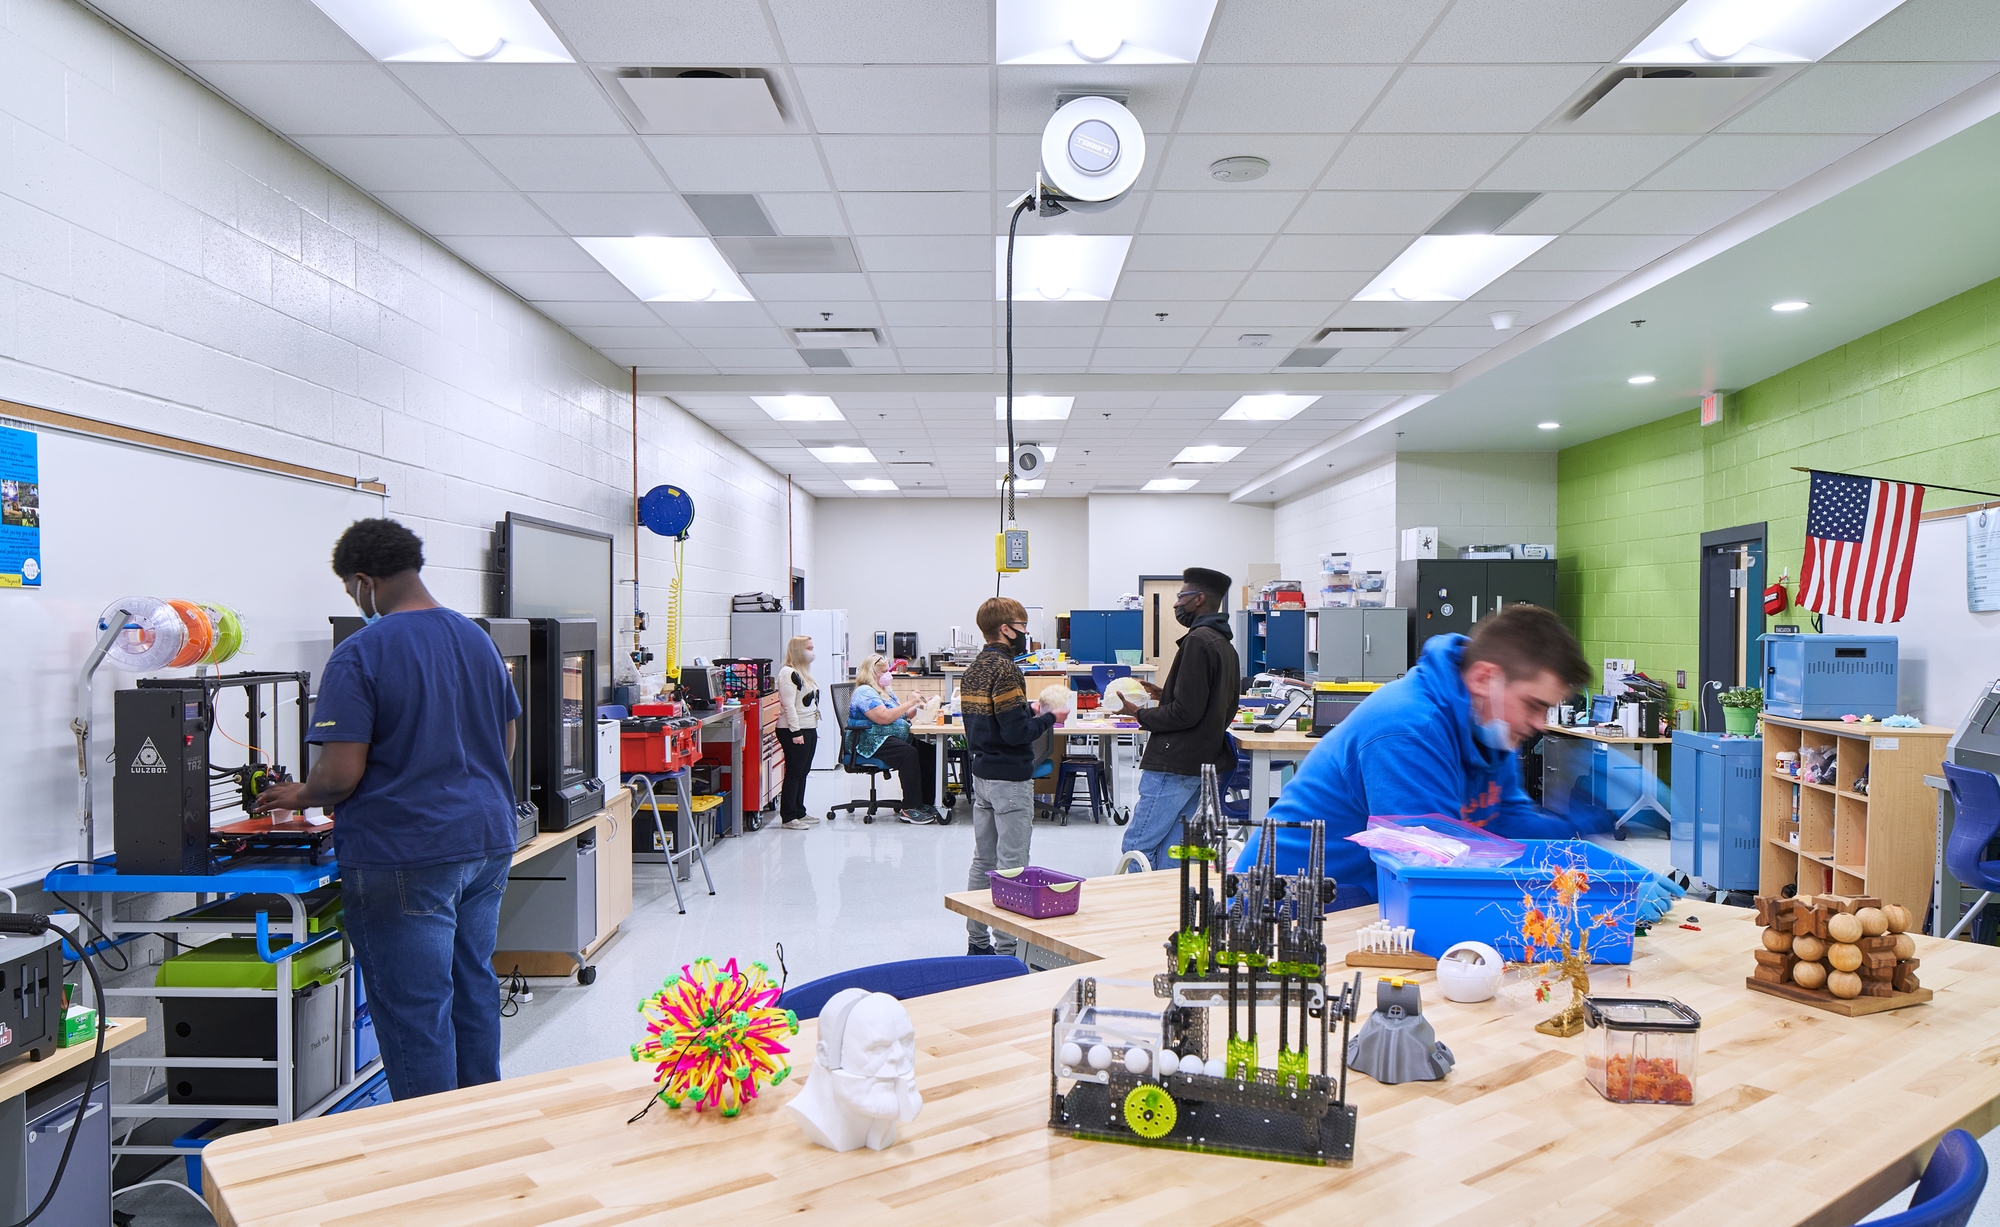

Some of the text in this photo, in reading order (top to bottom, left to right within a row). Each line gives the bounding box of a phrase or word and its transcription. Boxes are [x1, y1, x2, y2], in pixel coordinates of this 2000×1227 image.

[1076, 137, 1112, 155] HUBBELL
[187, 760, 202, 771] TAZ
[310, 1039, 321, 1051] Tech
